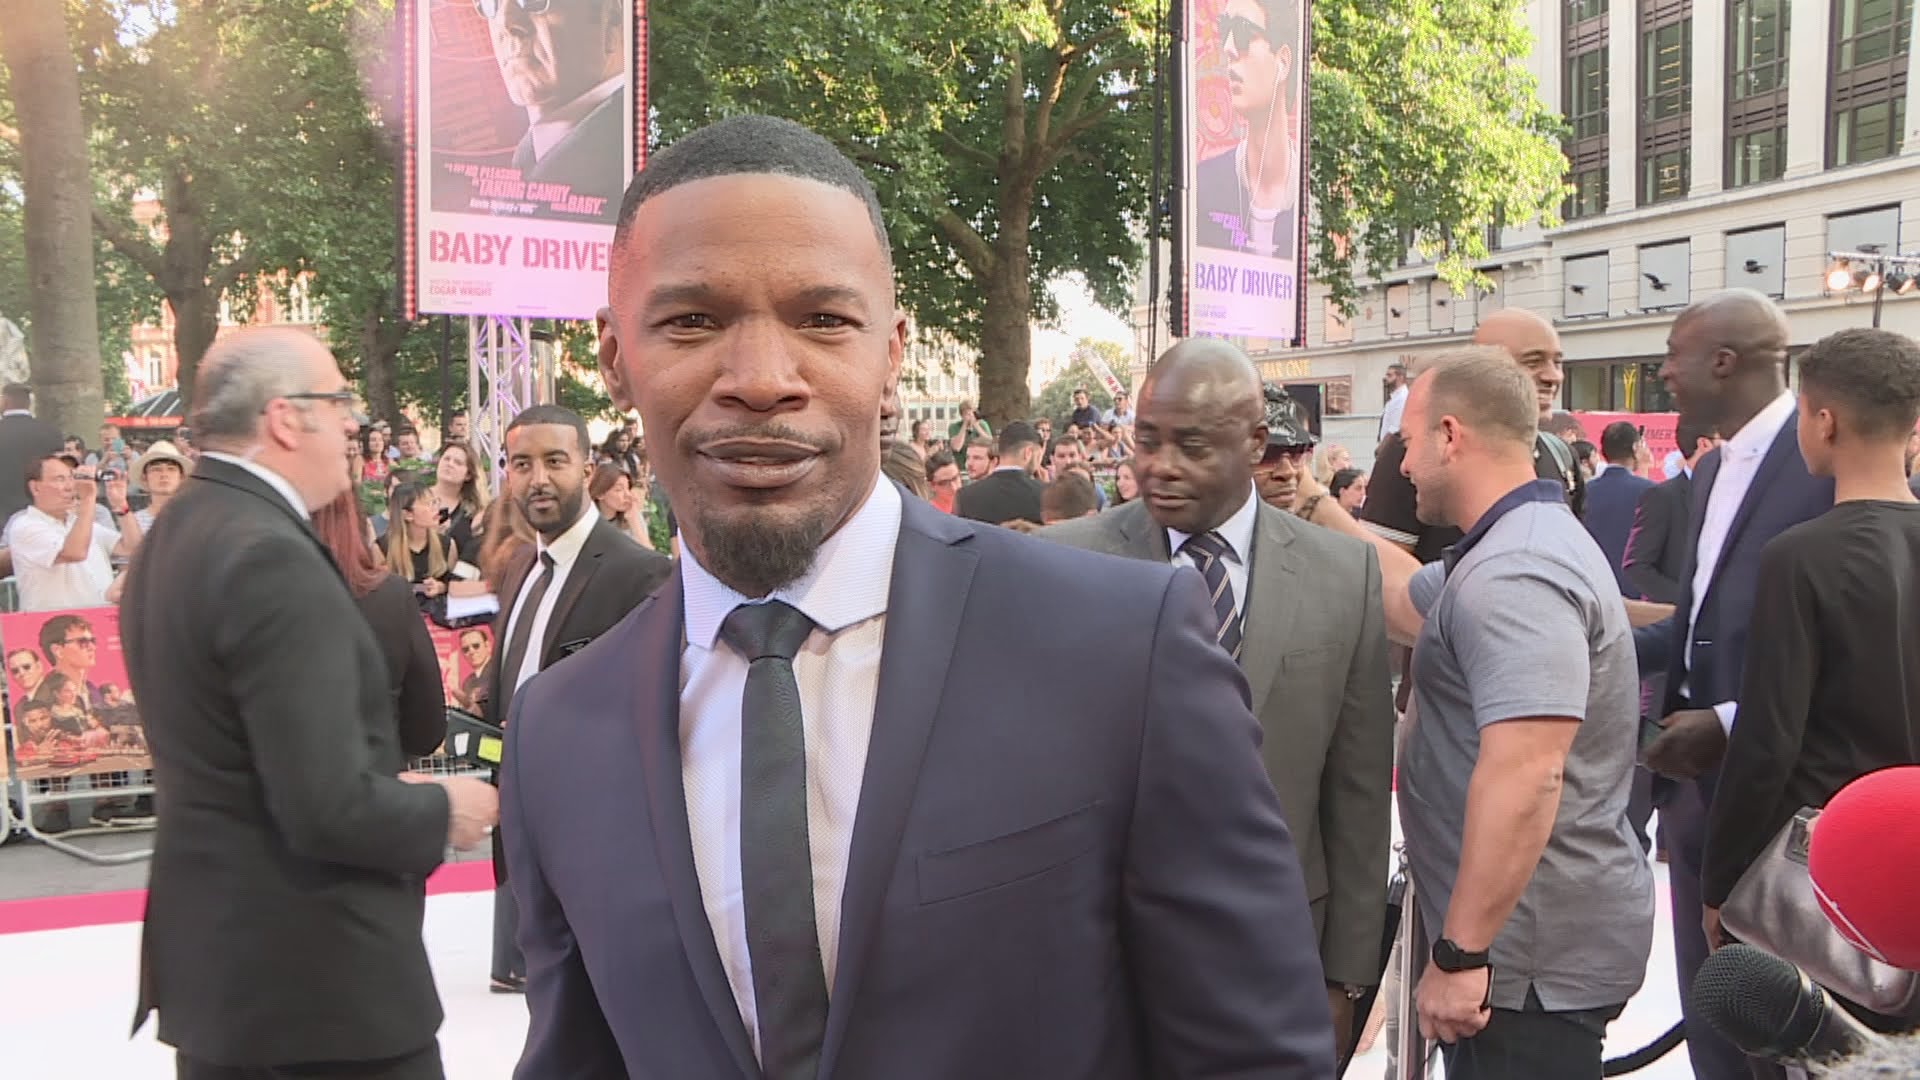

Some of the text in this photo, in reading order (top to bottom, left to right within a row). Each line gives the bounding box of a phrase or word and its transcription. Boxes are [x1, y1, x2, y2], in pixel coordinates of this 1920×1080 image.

[479, 179, 526, 200] TAKING
[526, 182, 571, 203] CANDY
[428, 230, 513, 266] BABY
[429, 285, 492, 297] EDGAR WRIGHT
[1194, 262, 1294, 300] BABY DRIVER
